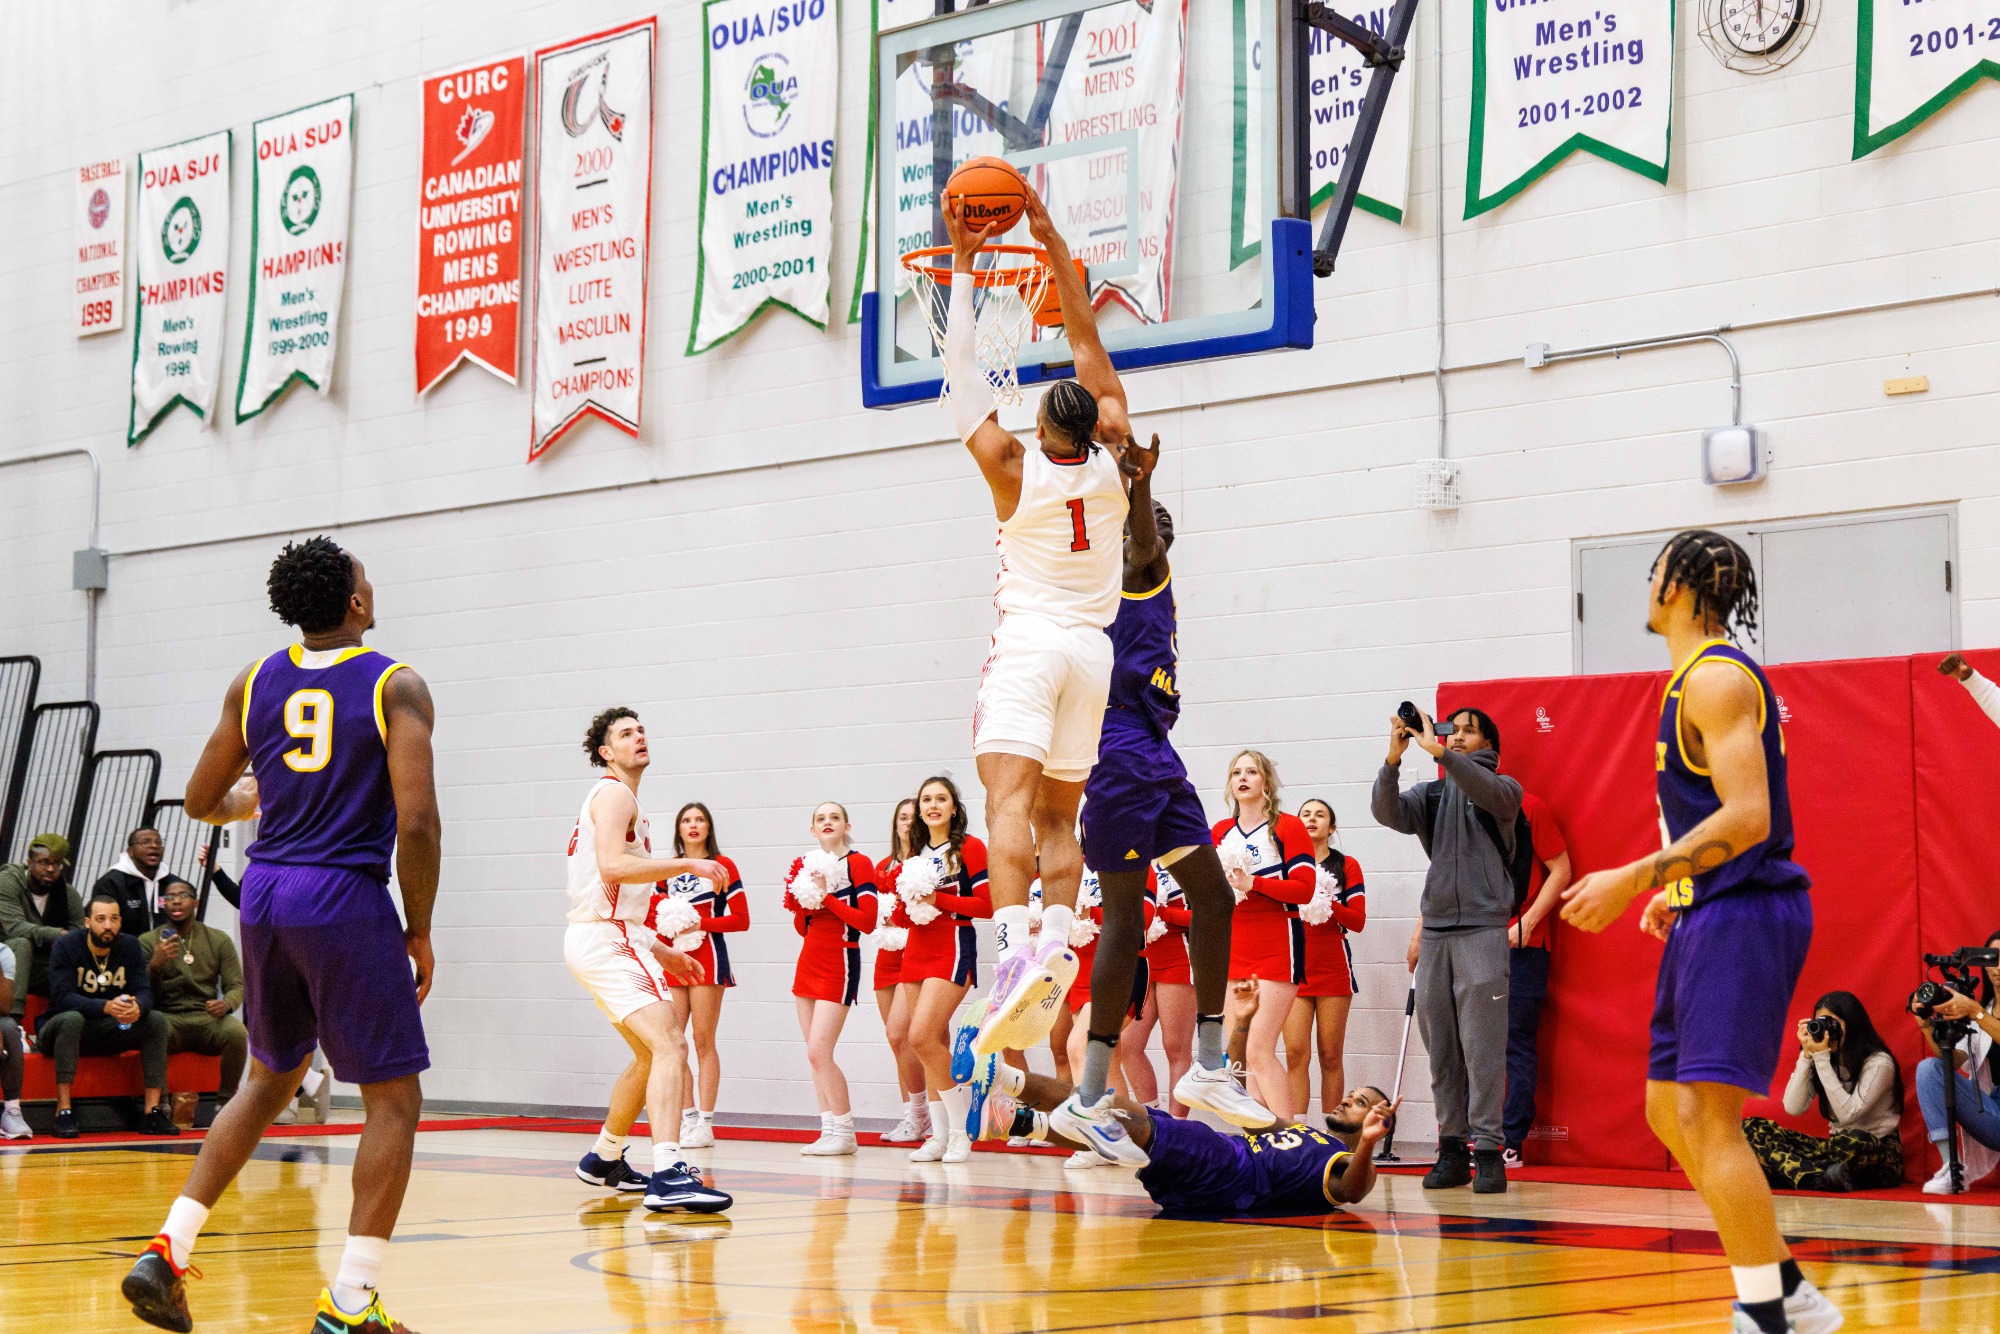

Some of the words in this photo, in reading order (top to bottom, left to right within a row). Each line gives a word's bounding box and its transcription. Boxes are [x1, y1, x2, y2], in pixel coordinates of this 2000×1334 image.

[712, 0, 825, 50] OUA/SUO
[1085, 20, 1138, 60] 2001
[1535, 11, 1617, 46] Men's
[1772, 26, 1780, 35] 5
[1909, 17, 2000, 57] 2001-2
[1514, 38, 1644, 81] Wrestling
[438, 65, 509, 104] CURC
[752, 76, 798, 99] OUA
[1084, 66, 1135, 97] MEN'S
[1311, 65, 1362, 96] en's
[1064, 103, 1157, 142] WRESTLING
[1518, 86, 1642, 128] 2001-2002
[80, 159, 121, 183] BASEBALL
[574, 145, 613, 178] 2000
[713, 139, 834, 195] CHAMPIONS
[425, 158, 522, 200] CANADIAN
[422, 188, 521, 229] UNIVERSITY
[572, 204, 613, 231] MEN'S
[746, 193, 793, 218] Men's
[433, 220, 512, 257] ROWING
[733, 217, 813, 249] Wrestling
[78, 240, 118, 263] NATIONAL
[443, 252, 498, 284] MENS
[553, 237, 636, 273] WRESTLING
[77, 270, 120, 294] CHAMPIONS
[732, 256, 816, 290] 2000-2001
[281, 287, 314, 306] Men's
[417, 278, 520, 317] CHAMPIONS
[569, 277, 612, 305] LUTTE
[81, 299, 112, 327] 1999
[162, 316, 194, 333] Men's
[269, 310, 328, 332] Wrestling
[444, 313, 492, 343] 1999
[559, 312, 631, 345] MASCULIN
[158, 338, 198, 357] Rowing
[552, 367, 634, 400] CHAMPIONS
[1066, 498, 1090, 553] 1
[282, 688, 334, 773] 9
